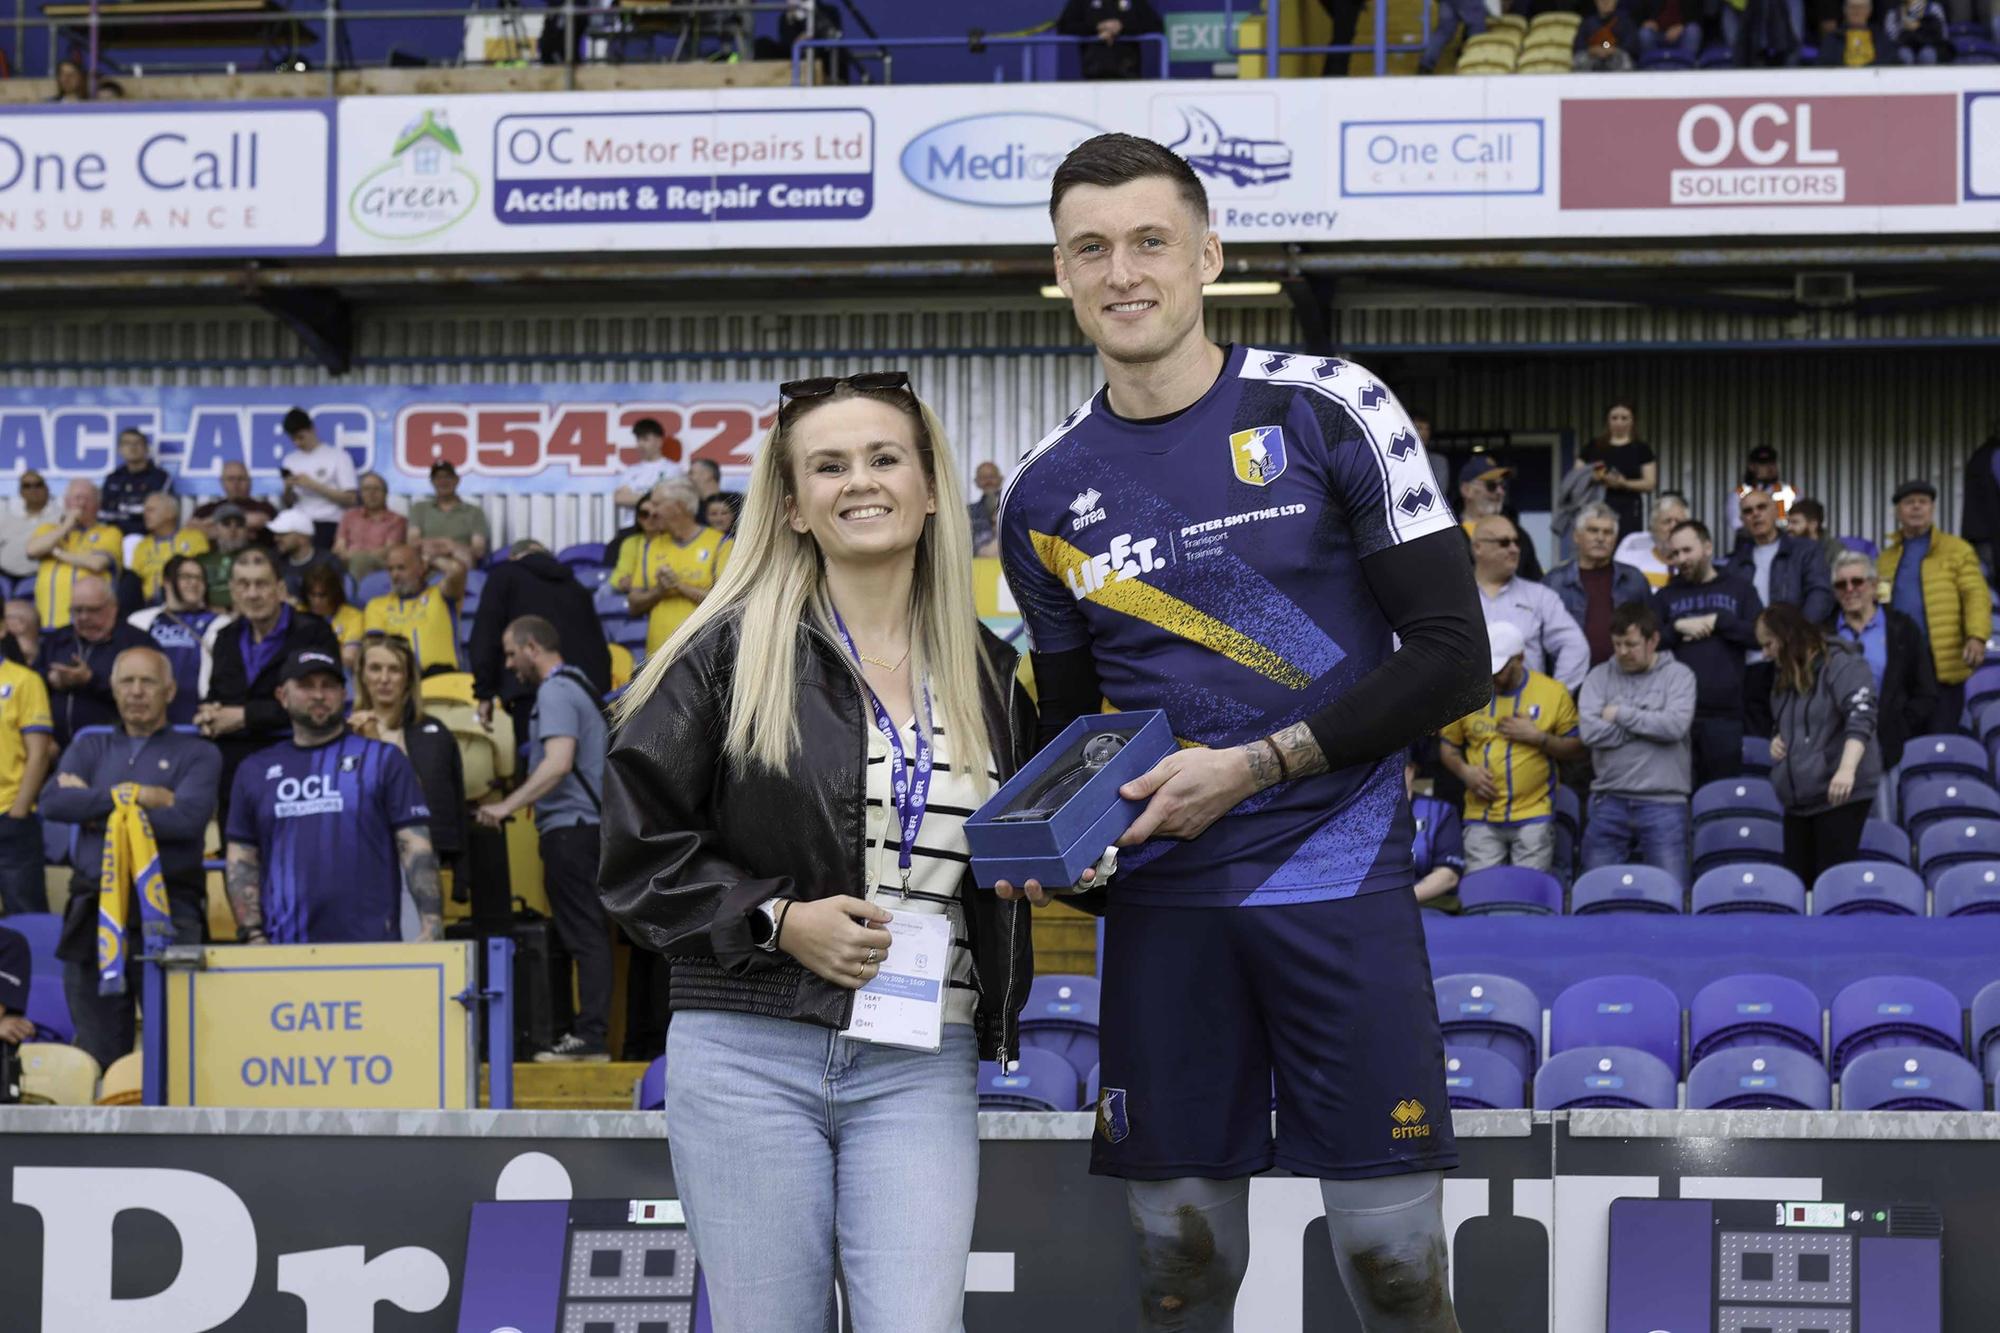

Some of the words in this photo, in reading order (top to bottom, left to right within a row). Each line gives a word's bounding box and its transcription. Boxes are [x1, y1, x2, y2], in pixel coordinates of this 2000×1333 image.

[509, 127, 574, 165] OC
[584, 137, 680, 165] Motor
[691, 135, 804, 167] Repairs
[815, 131, 863, 161] Ltd
[1368, 134, 1439, 164] One
[1452, 133, 1513, 163] Call
[1677, 102, 1840, 167] OCL
[137, 131, 259, 191] Call
[504, 184, 630, 214] Accident
[636, 186, 658, 211] &
[666, 182, 761, 216] Repair
[768, 183, 865, 209] Centre
[1678, 173, 1838, 198] SOLICITORS
[361, 185, 460, 216] Green
[1226, 208, 1339, 231] Recovery
[400, 407, 782, 472] 65432
[1072, 507, 1107, 531] errea
[1180, 518, 1223, 538] PETER
[1223, 507, 1280, 527] SMYTHE
[1279, 503, 1307, 516] LTD
[1182, 532, 1229, 549] Transport
[1185, 545, 1224, 561] Training
[893, 758, 903, 774] EFL
[276, 774, 341, 802] OCL
[915, 780, 925, 794] EFL
[908, 814, 919, 829] EFL
[270, 1001, 363, 1032] GATE
[240, 1056, 336, 1087] ONLY
[344, 1055, 393, 1085] TO
[1392, 1124, 1430, 1139] errea
